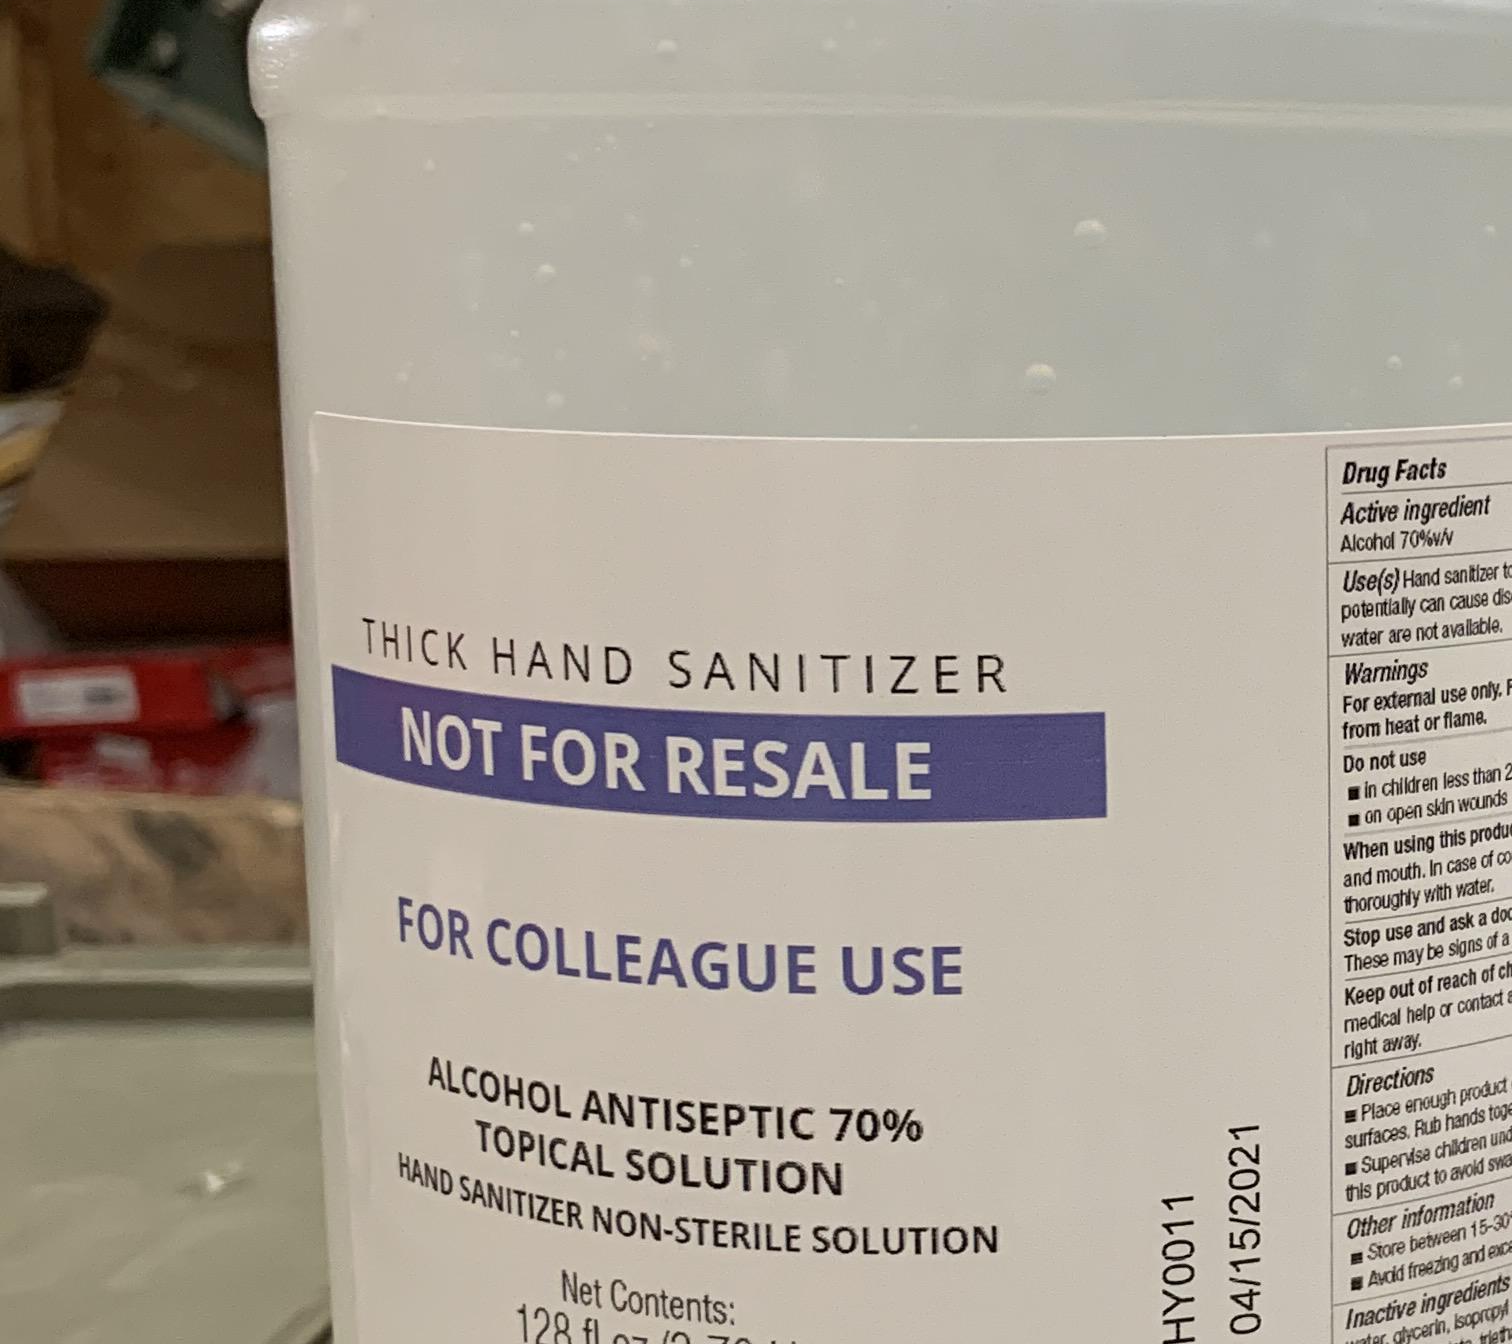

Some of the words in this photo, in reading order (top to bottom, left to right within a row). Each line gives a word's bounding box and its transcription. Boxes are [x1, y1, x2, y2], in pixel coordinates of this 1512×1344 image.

[1342, 461, 1391, 489] Drug
[1394, 456, 1447, 482] Facts
[1340, 499, 1400, 526] Active
[1403, 494, 1491, 526] ingredient
[1340, 530, 1395, 553] Alcohol
[1342, 567, 1400, 597] Use(s)
[1402, 567, 1441, 589] Hand
[1444, 563, 1500, 585] sanitizer
[1341, 596, 1417, 624] potentially
[1419, 596, 1445, 614] can
[1449, 592, 1489, 611] cause
[1341, 627, 1384, 648] water
[1388, 628, 1412, 645] are
[1416, 621, 1439, 642] not
[1441, 615, 1503, 639] available.
[362, 618, 467, 670] THICK
[493, 637, 631, 684] HAND
[669, 650, 1006, 694] SANITIZER
[1345, 658, 1429, 686] Warnings
[1343, 695, 1371, 714] For
[1373, 687, 1436, 711] external
[1441, 686, 1468, 705] use
[1470, 680, 1503, 702] only.
[1342, 721, 1381, 740] from
[1385, 714, 1420, 736] heat
[1423, 715, 1441, 732] or
[1442, 710, 1487, 730] flame.
[402, 707, 502, 775] NOT
[522, 725, 645, 791] FOR
[667, 739, 931, 799] RESALE
[1343, 754, 1365, 774] Do
[1369, 750, 1396, 771] not
[1399, 750, 1427, 768] use
[1364, 780, 1377, 799] in
[1381, 775, 1438, 797] children
[1443, 771, 1470, 790] less
[1472, 767, 1502, 786] than
[1364, 808, 1382, 825] on
[1386, 804, 1423, 825] open
[1426, 797, 1455, 817] skin
[1457, 788, 1508, 813] wounds
[1342, 841, 1389, 861] When
[1393, 834, 1435, 855] using
[1439, 828, 1467, 849] this
[1343, 867, 1373, 888] and
[1376, 861, 1426, 885] mouth.
[1429, 858, 1443, 878] In
[1446, 856, 1477, 874] case
[1480, 849, 1494, 869] of
[1343, 887, 1421, 914] thoroughly
[1423, 882, 1452, 904] with
[1455, 878, 1495, 899] water.
[398, 896, 473, 959] FOR
[487, 919, 816, 994] COLLEAGUE
[842, 947, 962, 995] USE
[1343, 927, 1381, 948] Stop
[1385, 924, 1413, 942] use
[1417, 915, 1445, 938] and
[1449, 911, 1475, 932] ask
[1478, 912, 1488, 927] a
[1343, 952, 1390, 973] These
[1393, 947, 1425, 966] may
[1426, 942, 1444, 961] be
[1448, 937, 1483, 958] signs
[1486, 930, 1499, 950] of
[1501, 932, 1510, 947] a
[1344, 986, 1386, 1007] Keep
[1389, 977, 1415, 1000] out
[1418, 974, 1434, 996] of
[1437, 968, 1477, 992] reach
[1481, 963, 1496, 984] of
[1344, 1007, 1401, 1034] medical
[1406, 1003, 1436, 1025] help
[1439, 1002, 1454, 1018] or
[1457, 988, 1504, 1014] contact
[1344, 1037, 1378, 1061] right
[1382, 1032, 1422, 1054] away.
[429, 1057, 571, 1118] ALCOHOL
[582, 1090, 813, 1140] ANTISEPTIC
[830, 1108, 923, 1142] 70%
[1346, 1066, 1435, 1098] Directions
[1361, 1101, 1401, 1122] Place
[1404, 1088, 1457, 1114] enough
[1459, 1077, 1508, 1107] product
[1344, 1125, 1410, 1150] surfaces.
[1414, 1115, 1442, 1138] Rub
[475, 1119, 614, 1177] TOPICAL
[626, 1149, 842, 1195] SOLUTION
[1361, 1147, 1431, 1175] Supervise
[399, 1152, 453, 1195] HAND
[460, 1176, 583, 1229] SANITIZER
[593, 1206, 800, 1252] NON-STERILE
[813, 1226, 997, 1255] SOLUTION
[1344, 1182, 1372, 1203] this
[1376, 1170, 1431, 1201] product
[1433, 1168, 1448, 1186] to
[1228, 1126, 1261, 1334] 04/15/2021
[1346, 1214, 1398, 1240] Other
[1401, 1192, 1495, 1230] information
[1366, 1240, 1406, 1261] Store
[1409, 1226, 1467, 1253] between
[1161, 1196, 1195, 1344] HY0011
[562, 1270, 602, 1308] Net
[611, 1279, 734, 1325] Contents:
[1345, 1299, 1417, 1330] Inactive
[1420, 1274, 1511, 1316] ingredients
